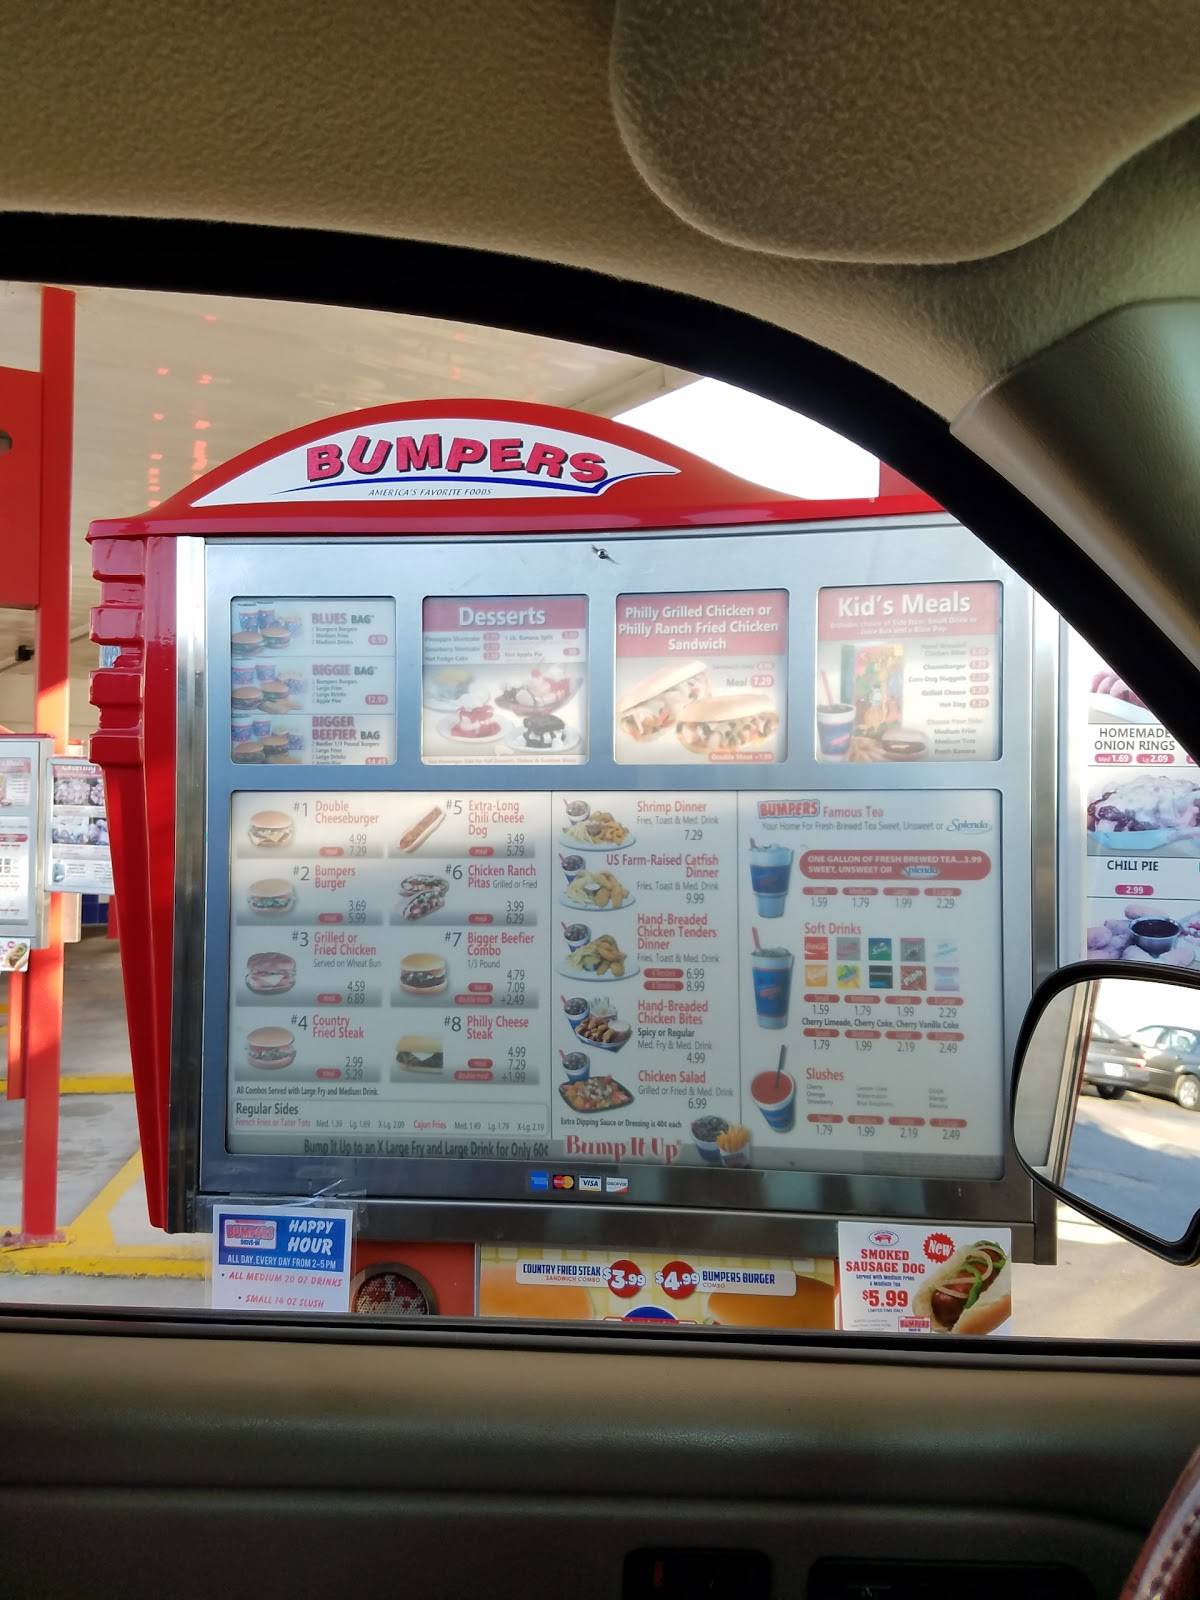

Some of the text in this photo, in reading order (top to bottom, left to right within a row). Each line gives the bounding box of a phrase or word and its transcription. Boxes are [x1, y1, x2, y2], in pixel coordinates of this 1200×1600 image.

[307, 433, 608, 482] BUMPERS
[369, 488, 493, 496] AMERICA'S FAVORITE FOODS
[838, 591, 970, 618] Kid's Meals
[312, 613, 372, 624] BLUES BAG
[459, 607, 547, 626] Desserts
[625, 604, 773, 621] Philly Grilled Chicken or
[620, 620, 779, 637] Philly Ranch Fried Chicken
[668, 638, 727, 651] Sandwich
[354, 666, 375, 676] BAG
[312, 716, 355, 728] BIGGER
[360, 731, 380, 740] BAG
[1099, 728, 1171, 739] HOMEMADE
[1094, 739, 1175, 751] ONION RINGS
[1112, 753, 1130, 763] 1.69
[1150, 754, 1169, 764] 2.09
[294, 800, 350, 817] #1 Double
[446, 799, 520, 815] #5 Extra-Long
[637, 800, 708, 815] Shrimp Dinner
[823, 807, 863, 819] Famous
[866, 806, 884, 818] Tea
[315, 812, 380, 827] Cheeseburger
[468, 812, 525, 823] Chili Cheese
[468, 824, 488, 838] Dog
[684, 829, 704, 841] 7.29
[349, 833, 367, 844] 4.99
[606, 853, 719, 866] US Farm-Raised Catfish
[1106, 859, 1159, 872] CHILI PIE
[293, 865, 356, 882] #2 Bumpers
[445, 864, 536, 880] #6 Chicken Ranch
[686, 867, 719, 879] Dinner
[315, 878, 346, 892] Burger
[468, 877, 491, 889] Pitas
[1125, 885, 1144, 895] 2.99
[686, 893, 705, 905] 9.99
[637, 913, 708, 926] Hand-Breaded
[637, 926, 718, 938] Chicken Tenders
[804, 922, 862, 935] Soft Drinks
[292, 931, 358, 948] #3 Grilled or
[444, 931, 535, 947] #7 Bigger Beefier
[637, 938, 670, 950] Dinner
[314, 944, 377, 956] Fried Chicken
[466, 945, 502, 956] Combo
[687, 968, 705, 980] 6.99
[637, 999, 709, 1012] Hand-Breaded
[291, 1014, 351, 1031] #4 Country
[443, 1015, 530, 1032] #8 Philly Cheese
[637, 1012, 703, 1024] Chicken Bites
[313, 1026, 365, 1039] Fried Steak
[466, 1028, 494, 1041] Steak
[637, 1028, 657, 1039] Spicy
[667, 1028, 696, 1040] Regular
[687, 1052, 706, 1063] 4.99
[637, 1070, 706, 1083] Chicken Salad
[805, 1067, 845, 1081] Slushes
[688, 1097, 707, 1109] 6.99
[236, 1102, 300, 1118] Regular Sides
[304, 1138, 329, 1154] Bump
[340, 1138, 351, 1155] Up
[353, 1140, 363, 1153] to
[365, 1143, 376, 1154] an
[377, 1140, 385, 1154] X
[386, 1139, 410, 1158] Large
[411, 1140, 425, 1159] Fry
[426, 1141, 442, 1155] and
[444, 1141, 468, 1159] Large
[470, 1141, 494, 1156] Drink
[496, 1141, 510, 1156] for
[511, 1142, 532, 1159] Only
[565, 1135, 676, 1166] Bump It Up
[288, 1219, 335, 1235] HAPPY
[287, 1236, 334, 1256] HOUR
[929, 1241, 952, 1256] New
[227, 1254, 240, 1264] ALL
[279, 1256, 291, 1267] DAY
[293, 1257, 311, 1268] FROM
[860, 1248, 910, 1261] SMOKED
[522, 1264, 601, 1277] COUNTRY FRIED STEAK
[846, 1261, 926, 1275] SAUSAGE DOG
[229, 1271, 244, 1281] ALL
[246, 1272, 282, 1283] MEDIUM
[284, 1274, 295, 1283] 20
[311, 1277, 344, 1287] DRINKS
[601, 1267, 647, 1290] $3.99
[655, 1269, 700, 1292] $4.99
[702, 1270, 776, 1285] BUMPERS BURGER
[245, 1294, 273, 1305] SMALL
[286, 1297, 297, 1306] OZ
[299, 1297, 325, 1308] SLUSH
[862, 1289, 909, 1308] $5.99
